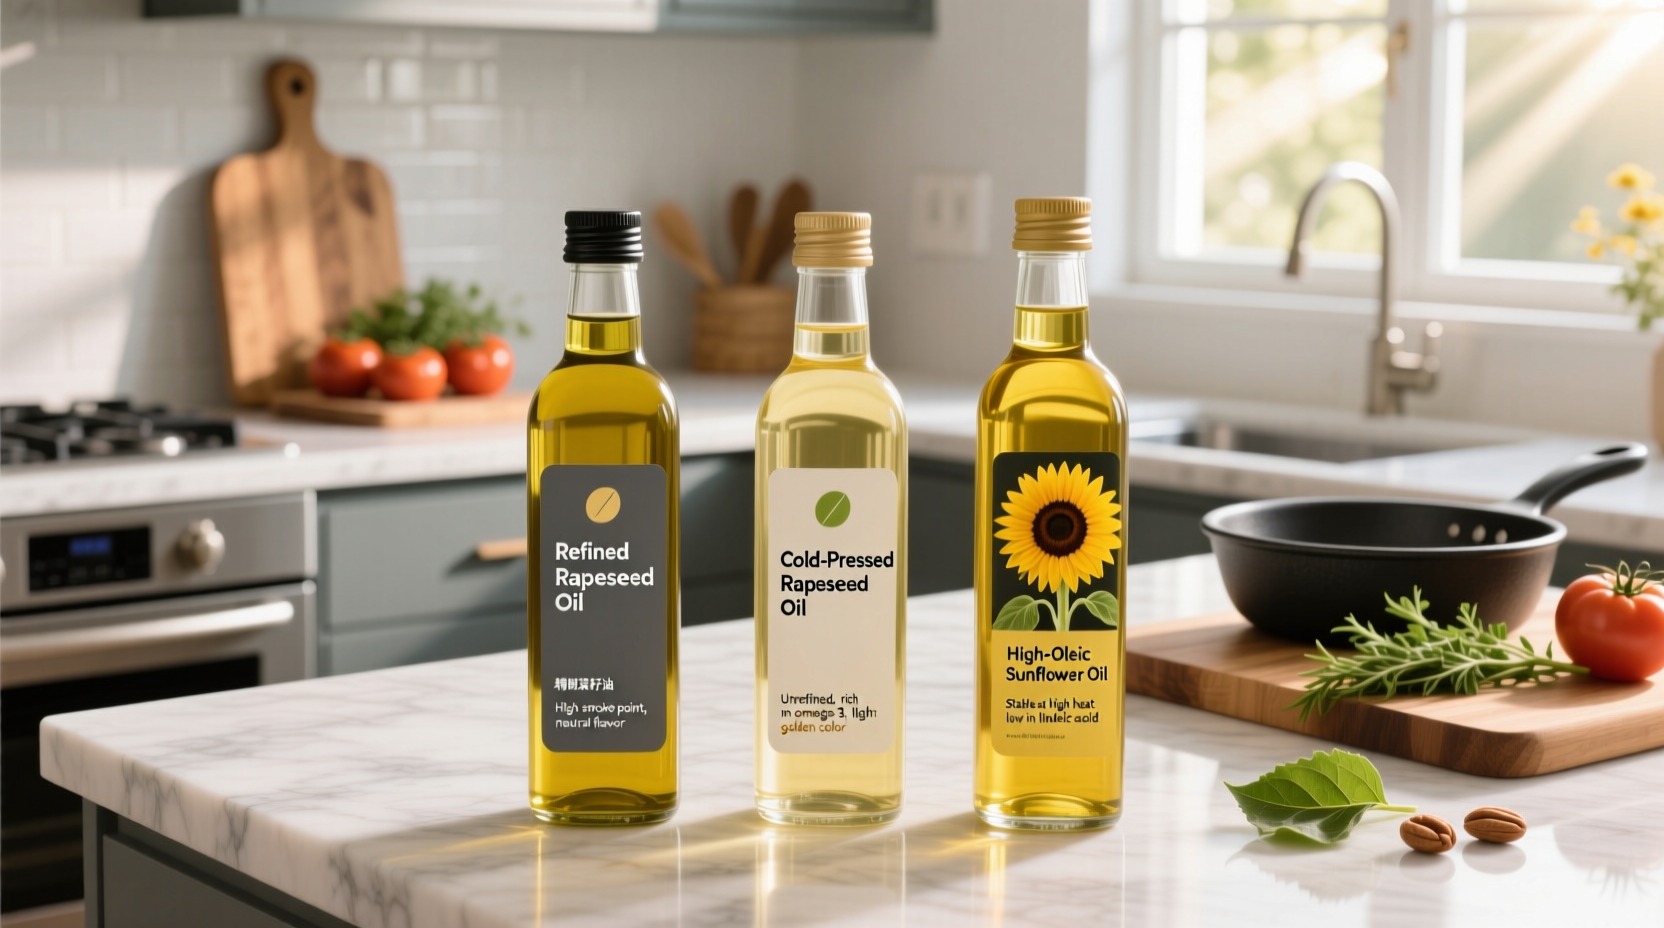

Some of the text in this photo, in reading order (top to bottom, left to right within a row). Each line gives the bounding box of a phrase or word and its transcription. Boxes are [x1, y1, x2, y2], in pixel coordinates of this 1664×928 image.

[555, 541, 629, 560] Refined
[780, 550, 894, 568] Cold-Pressed
[555, 566, 654, 591] Rapeseed
[781, 574, 868, 597] Rapeseed
[555, 592, 583, 612] Oil
[780, 598, 806, 616] Oil
[1007, 645, 1091, 665] High-Oleic
[1006, 665, 1108, 682] Sunflower Oil
[841, 693, 859, 705] rich
[819, 720, 847, 732] color
[1006, 712, 1024, 723] low
[1026, 712, 1036, 723] in
